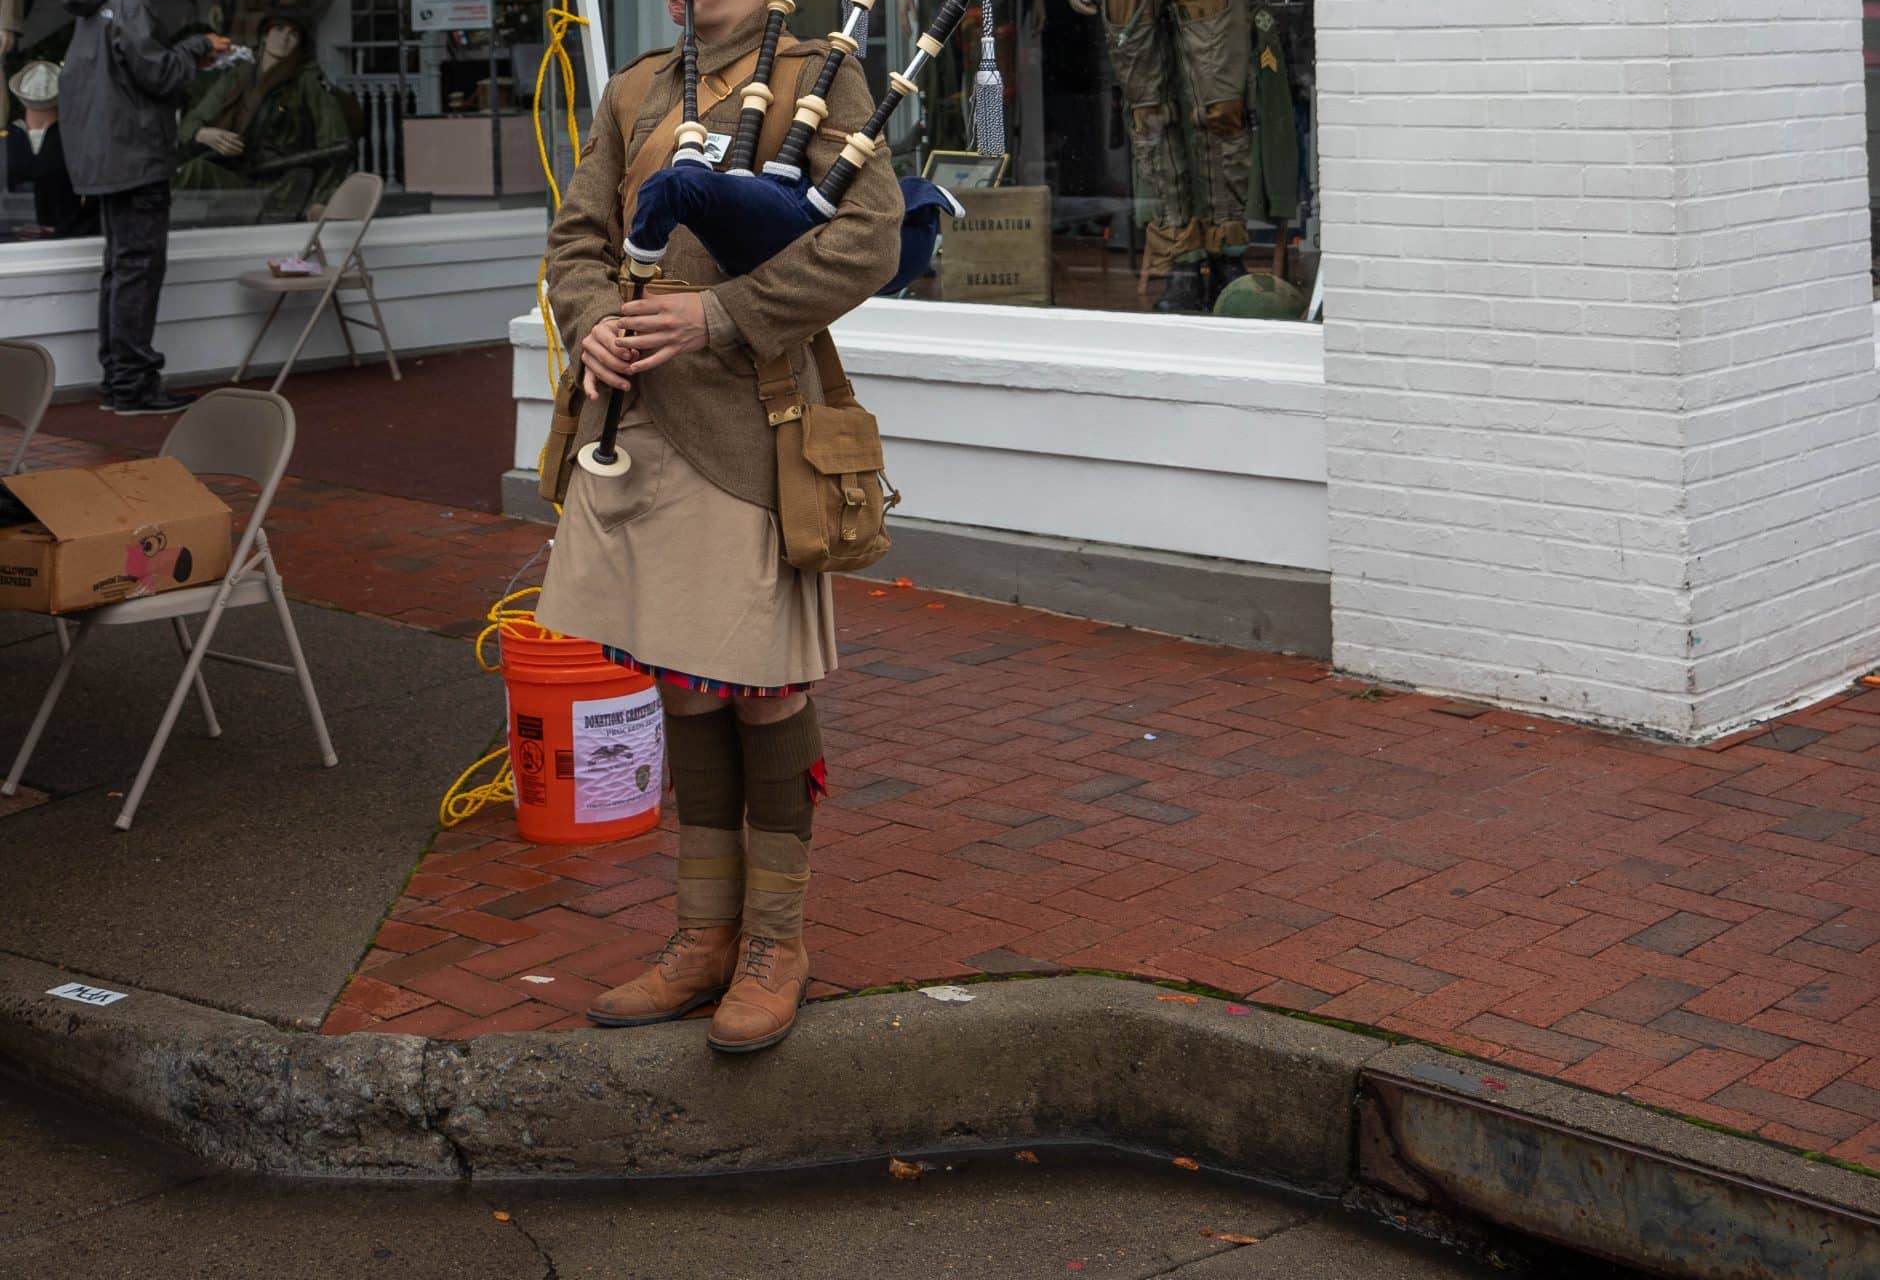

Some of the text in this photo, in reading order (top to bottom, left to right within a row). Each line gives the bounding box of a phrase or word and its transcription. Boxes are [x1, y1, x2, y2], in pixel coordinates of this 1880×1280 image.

[952, 219, 1031, 232] CALIBRATION
[966, 272, 1020, 285] HEADSET
[584, 711, 624, 728] DONATIONS
